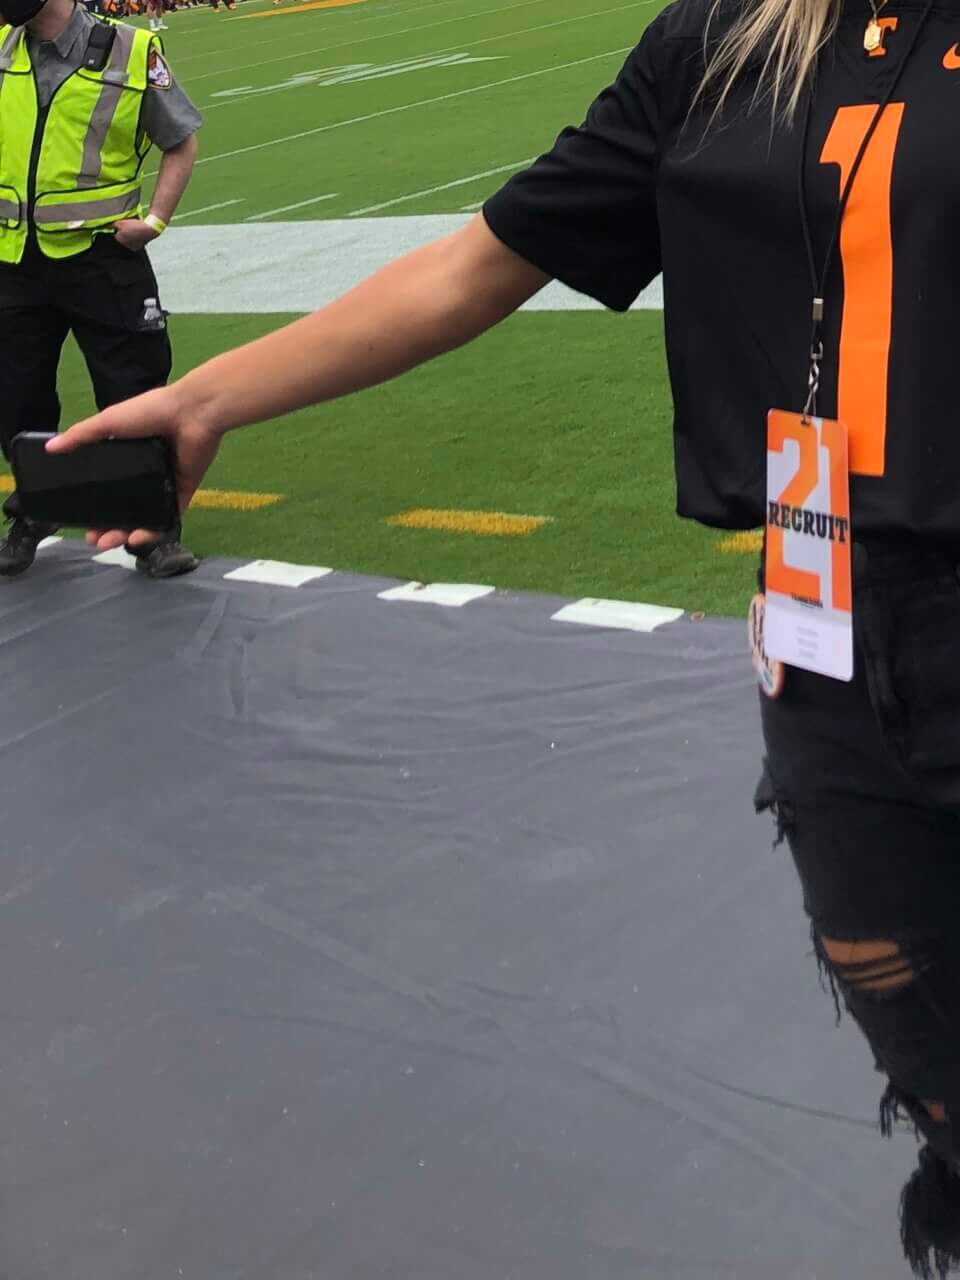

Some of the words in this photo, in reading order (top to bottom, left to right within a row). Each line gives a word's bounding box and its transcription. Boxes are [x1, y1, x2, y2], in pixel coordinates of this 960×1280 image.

[820, 102, 905, 476] 1
[767, 409, 852, 613] 21
[768, 499, 848, 544] RECRUIT
